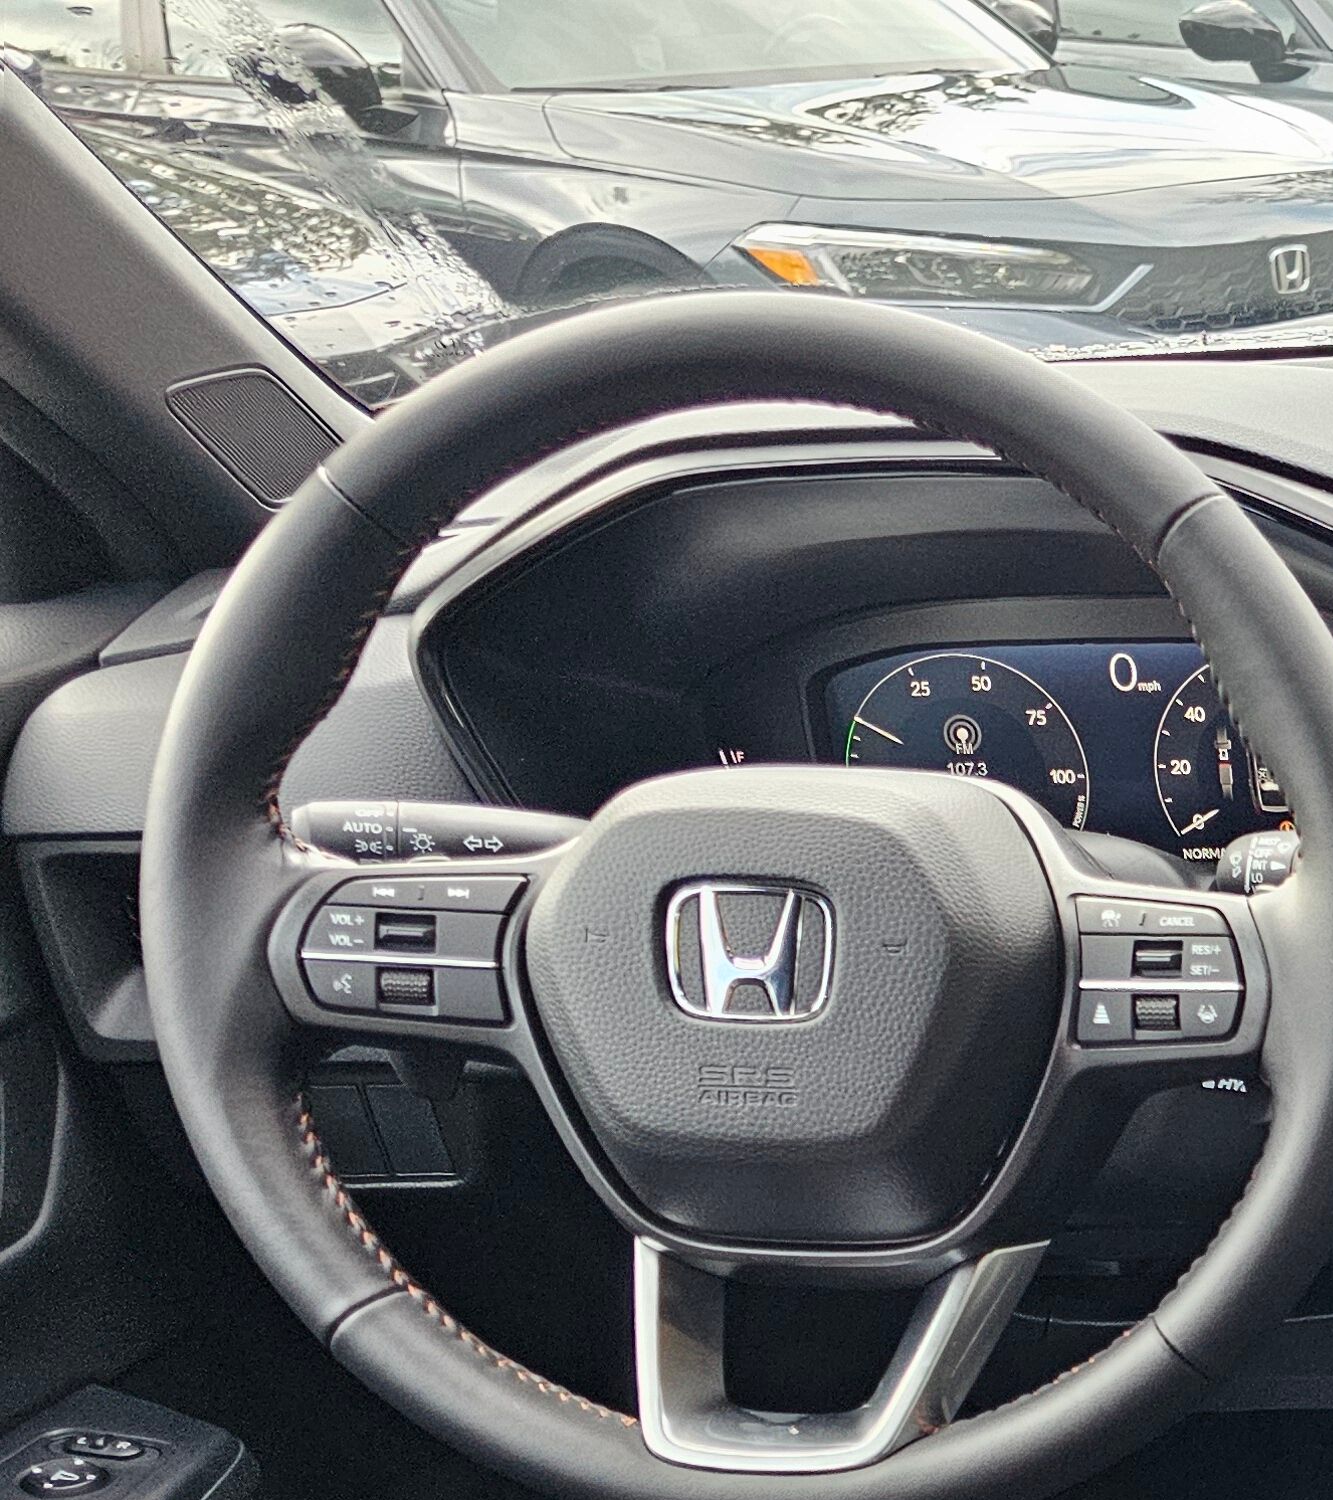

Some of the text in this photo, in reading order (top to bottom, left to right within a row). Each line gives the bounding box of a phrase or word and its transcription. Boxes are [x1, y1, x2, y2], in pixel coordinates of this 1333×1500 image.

[1109, 653, 1162, 693] 0 mph
[910, 681, 931, 697] 25
[971, 675, 992, 692] 50
[1026, 709, 1047, 726] 75
[1184, 706, 1206, 723] 40
[955, 743, 974, 755] FM
[946, 762, 989, 777] 107.3
[1170, 759, 1192, 775] 20
[1050, 769, 1076, 785] 100
[342, 821, 383, 834] AUTO
[1252, 860, 1268, 871] INT
[1251, 873, 1264, 883] LO
[1160, 917, 1195, 926] CANCEL
[698, 1065, 796, 1086] SRS
